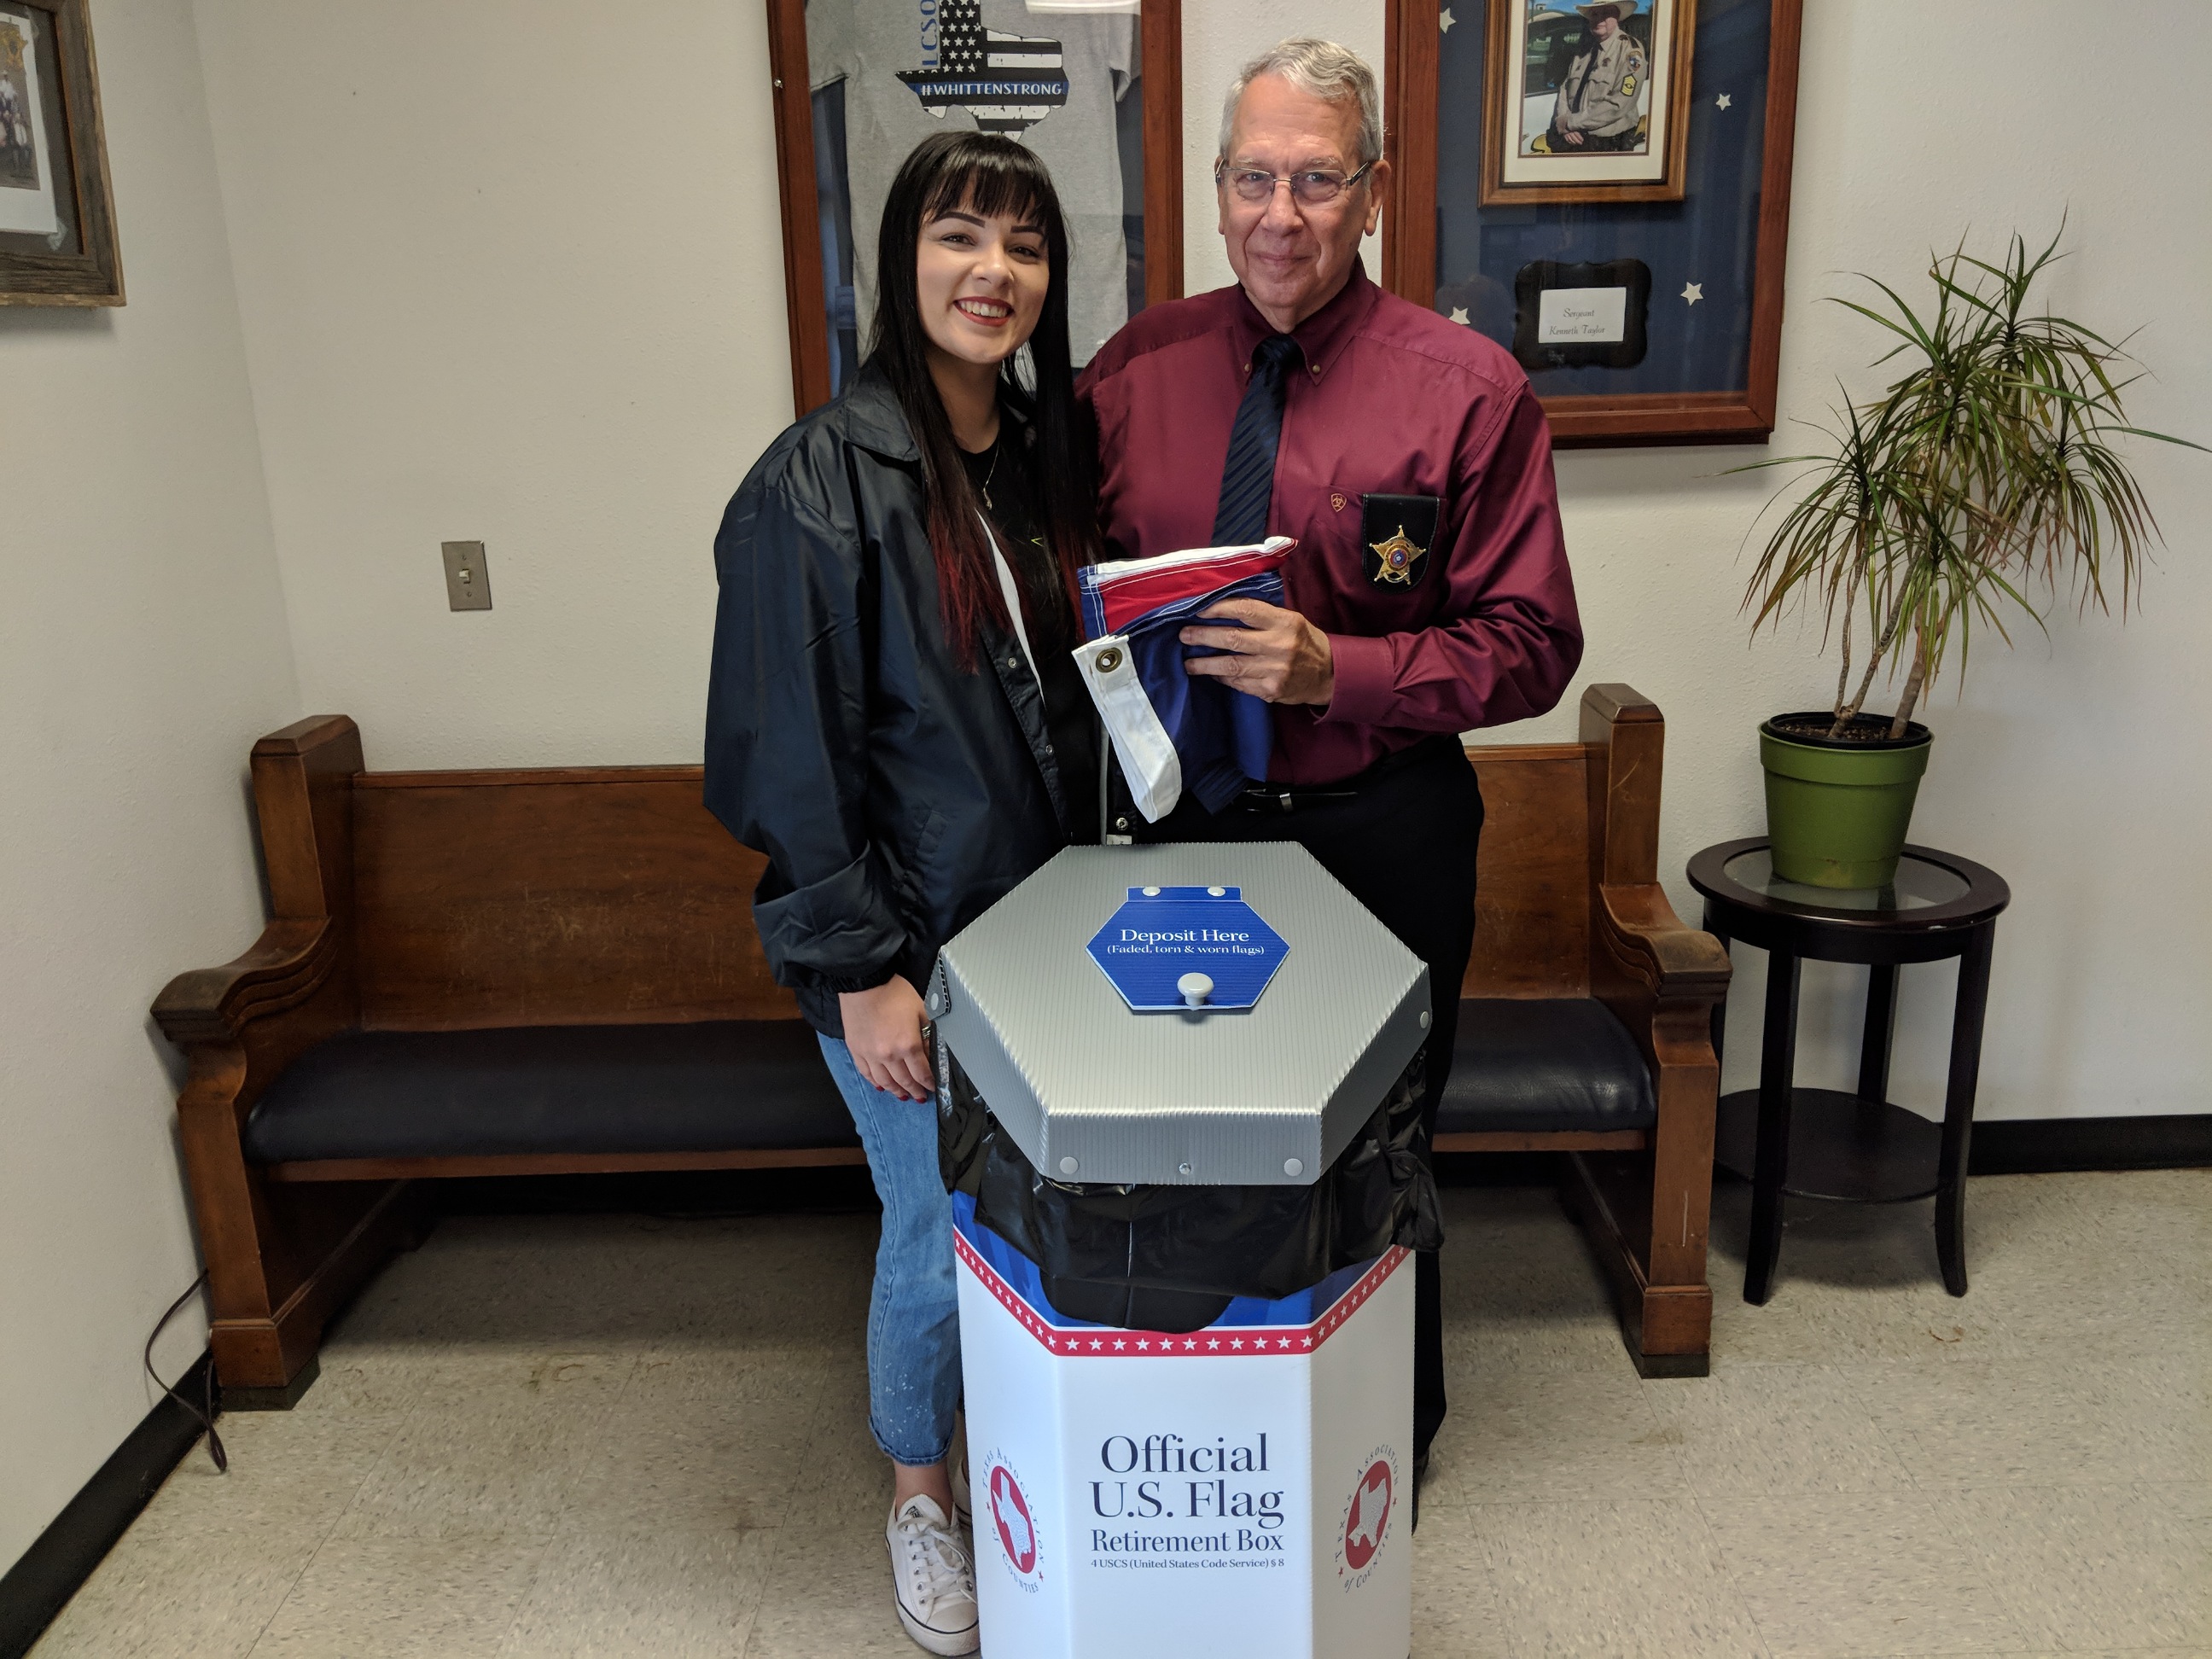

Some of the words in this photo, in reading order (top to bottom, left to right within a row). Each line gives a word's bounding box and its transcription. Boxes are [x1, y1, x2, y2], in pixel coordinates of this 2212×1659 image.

[920, 0, 938, 65] LCSO
[921, 84, 1062, 96] #WHITTENSTRONG
[1563, 308, 1595, 320] Sergeant
[1549, 326, 1579, 335] Kenneth
[1582, 324, 1605, 337] Taylor
[1121, 928, 1197, 944] Deposit
[1202, 929, 1249, 941] Here
[1107, 945, 1152, 954] (Faded,
[1155, 945, 1181, 953] torn
[1185, 945, 1195, 953] &
[1232, 945, 1265, 956] flags)
[1101, 1433, 1270, 1473] Official
[1088, 1481, 1173, 1518] U.S.
[1185, 1479, 1284, 1529] Flag
[1091, 1528, 1231, 1551] Retirement
[1236, 1528, 1285, 1551] Box
[1091, 1559, 1097, 1568] 4
[1099, 1559, 1128, 1569] USCS
[1129, 1558, 1167, 1569] (United
[1169, 1559, 1200, 1569] States
[1201, 1558, 1228, 1569] Code
[1230, 1557, 1269, 1569] Service)
[1278, 1558, 1284, 1567] 8
